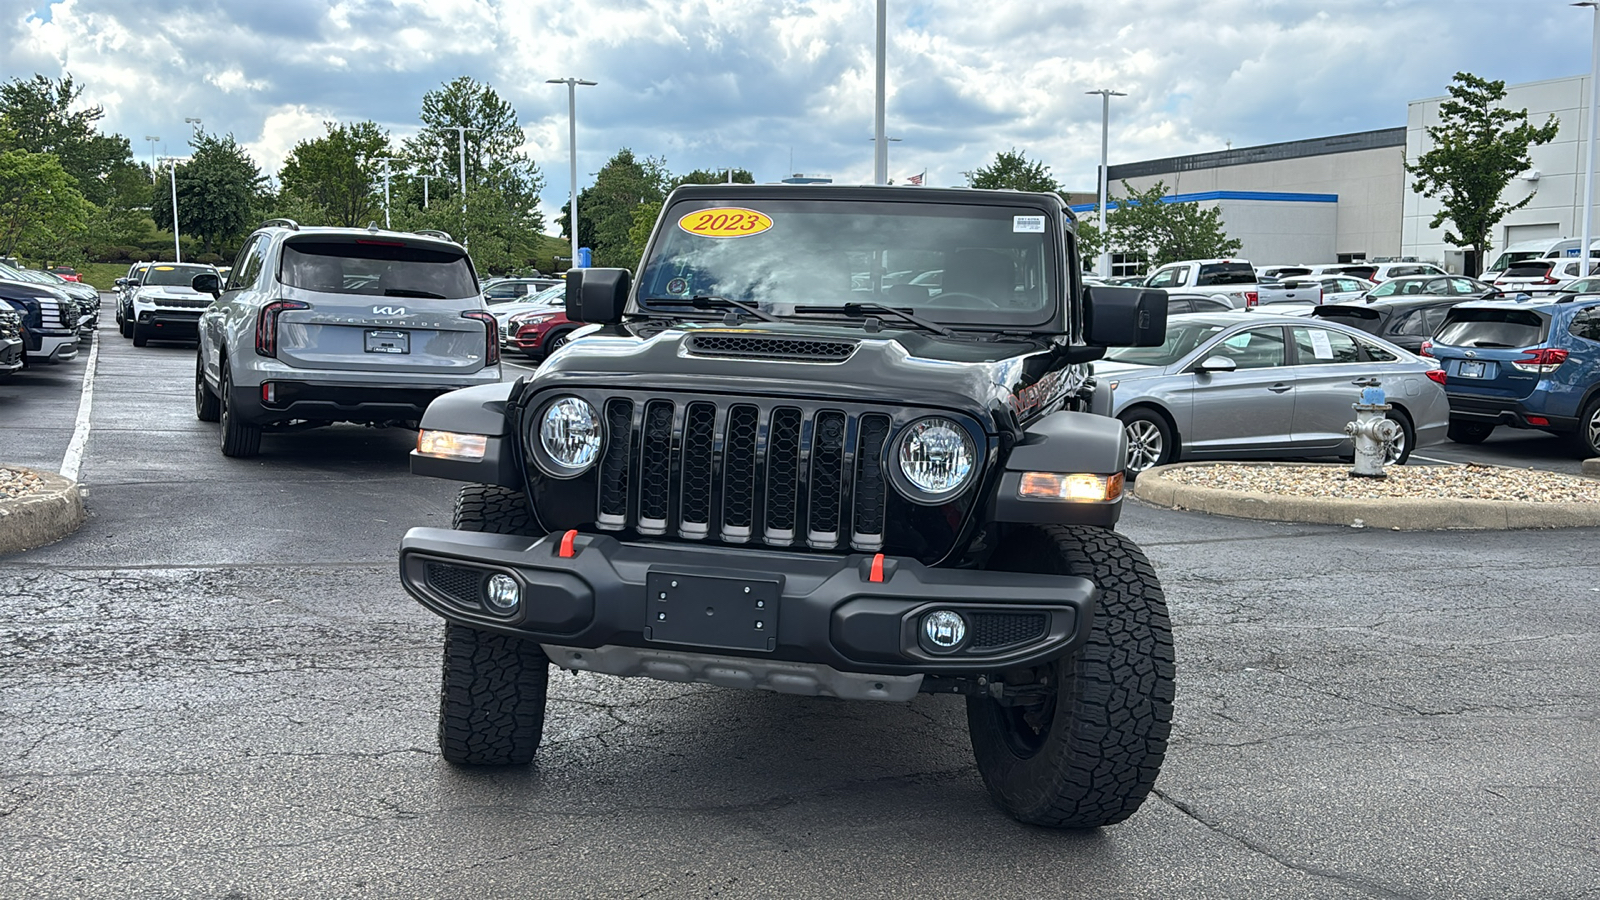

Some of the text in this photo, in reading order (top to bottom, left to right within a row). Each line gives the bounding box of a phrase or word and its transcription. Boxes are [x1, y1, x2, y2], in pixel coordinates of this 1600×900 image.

[692, 213, 760, 231] 2023
[372, 305, 406, 316] KIA
[335, 317, 440, 328] TELLURIDE
